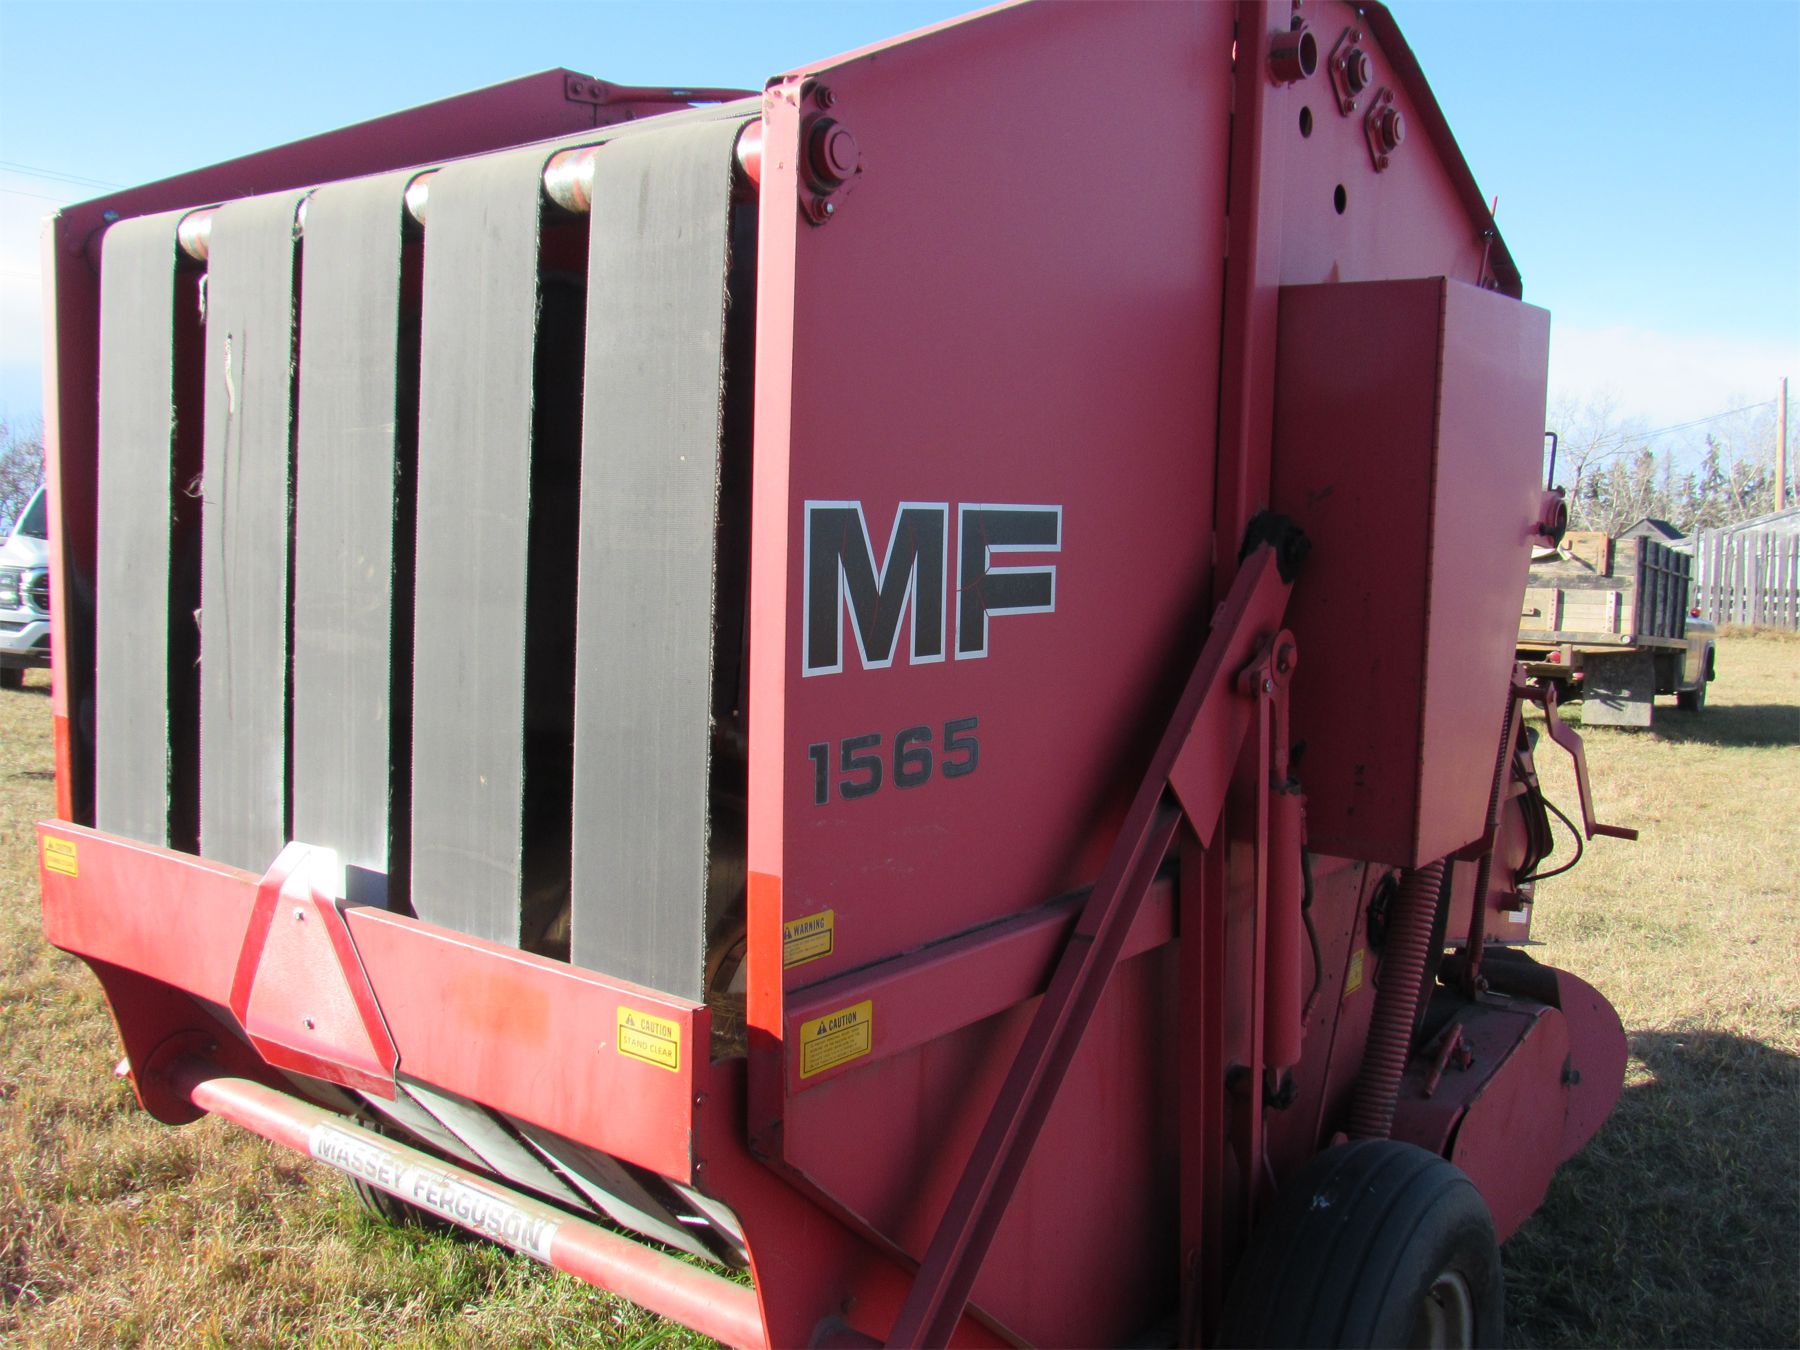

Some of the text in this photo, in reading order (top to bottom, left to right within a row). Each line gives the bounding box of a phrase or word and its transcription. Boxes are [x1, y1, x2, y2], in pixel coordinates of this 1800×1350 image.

[802, 500, 1062, 678] MF
[808, 716, 979, 806] 1565
[793, 917, 825, 937] WARNING
[640, 1018, 672, 1038] CAUTION
[828, 1011, 857, 1032] CAUTION
[623, 1035, 673, 1058] STAND CLEAR
[317, 1137, 545, 1251] MASSEY FERGUSON
